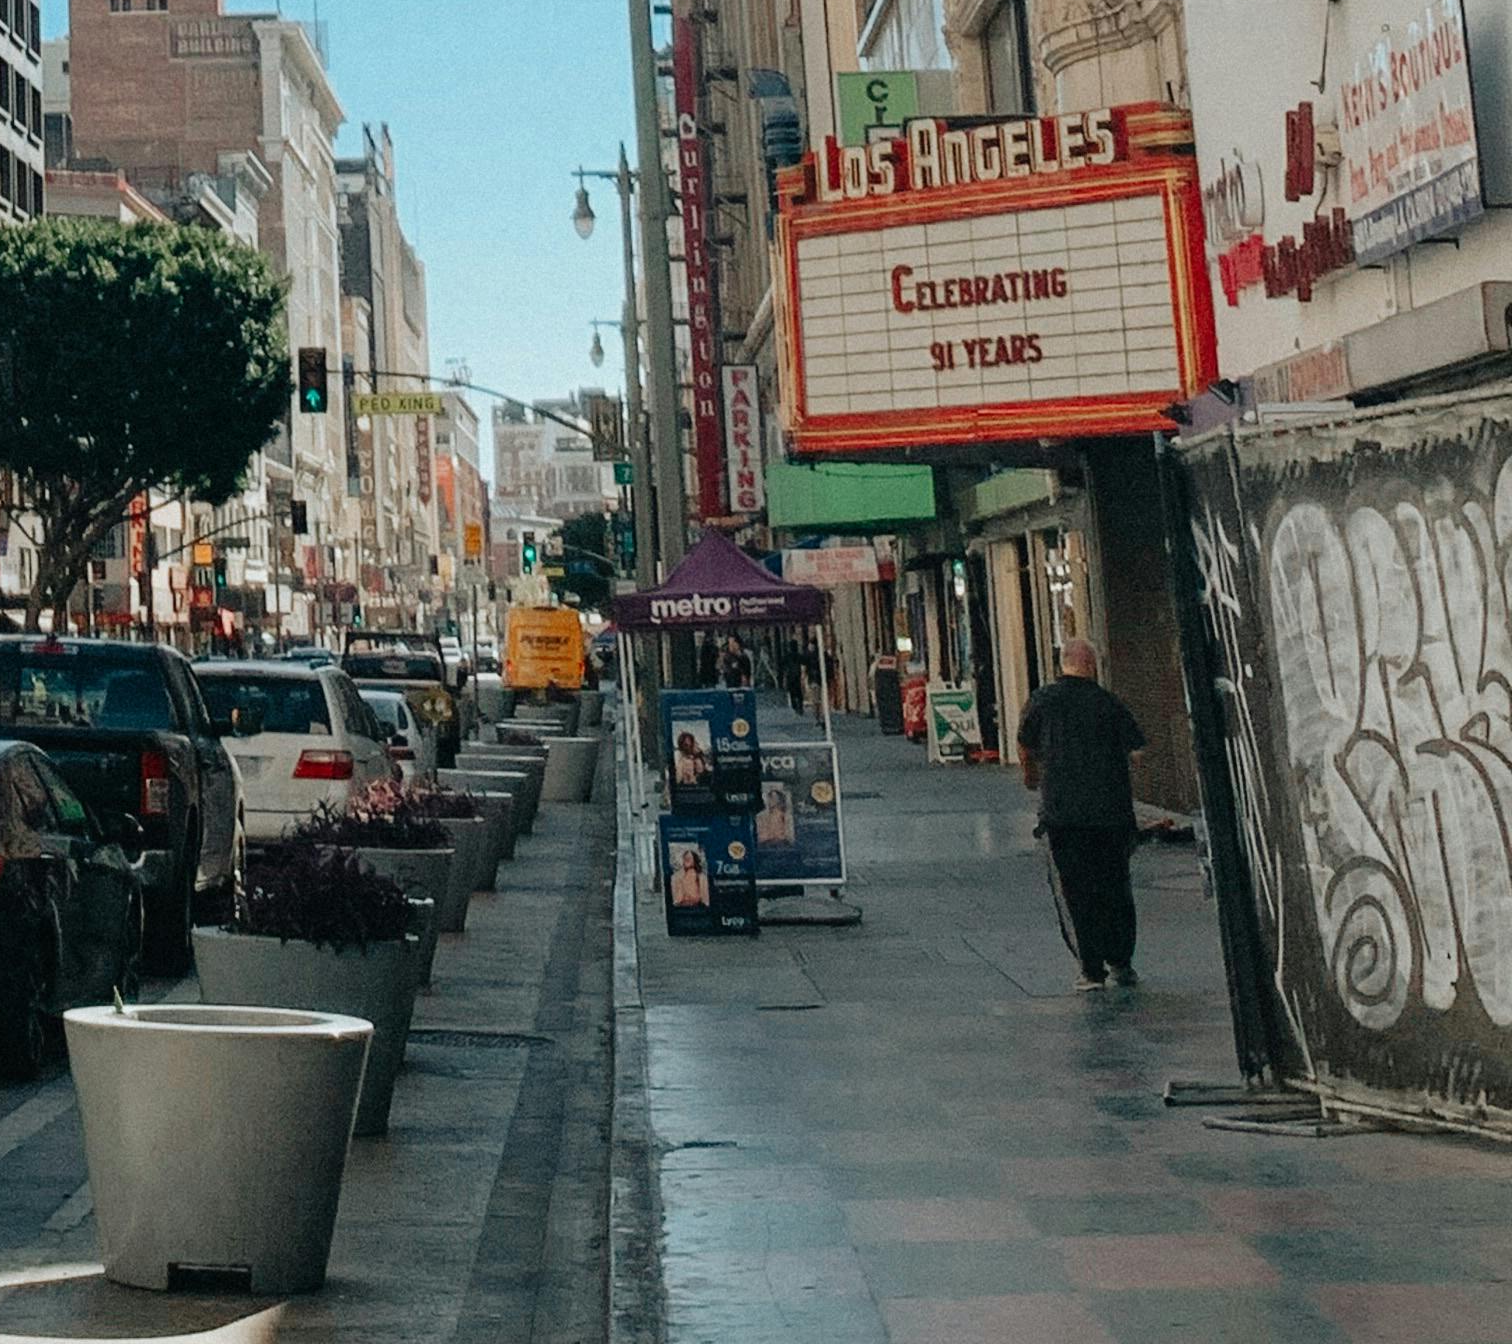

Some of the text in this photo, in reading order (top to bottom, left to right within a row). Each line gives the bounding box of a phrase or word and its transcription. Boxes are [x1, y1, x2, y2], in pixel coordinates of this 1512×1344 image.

[815, 107, 1117, 204] LOS ANGELES
[930, 333, 1044, 372] 91 YEARS
[359, 397, 435, 411] PED XING
[730, 369, 757, 509] PARKING
[650, 593, 732, 618] metro
[759, 755, 795, 774] yca
